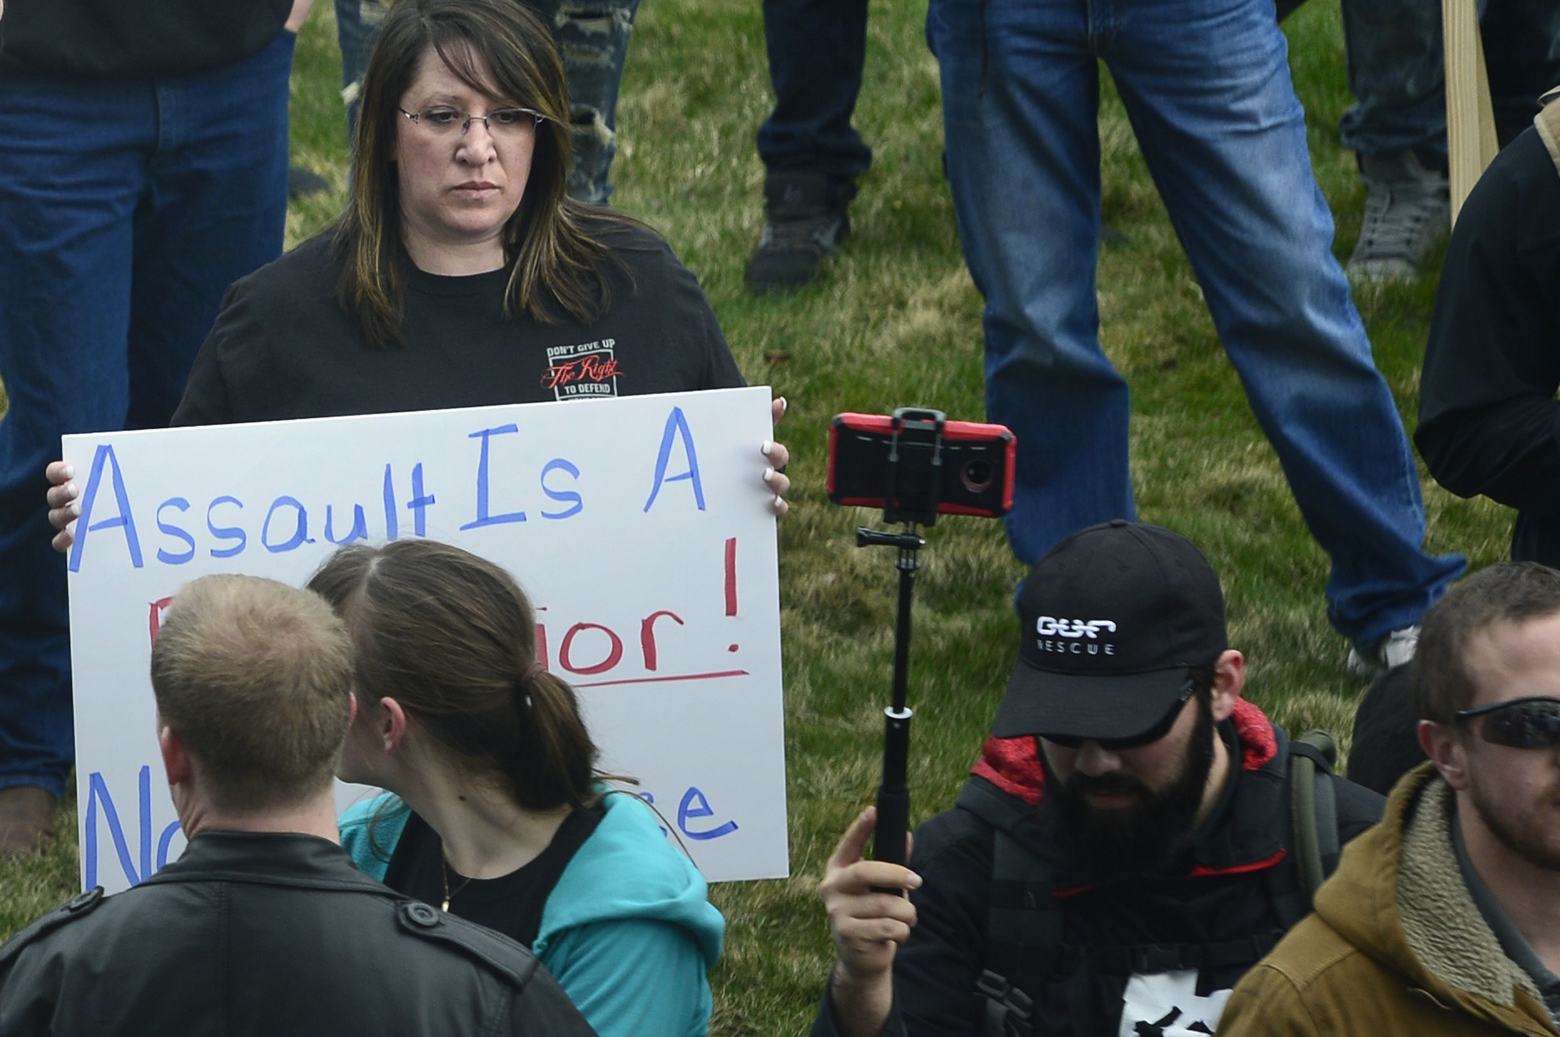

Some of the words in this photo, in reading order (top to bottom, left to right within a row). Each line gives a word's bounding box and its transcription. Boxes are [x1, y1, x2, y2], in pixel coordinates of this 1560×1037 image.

[546, 345, 575, 357] DON'T
[577, 341, 600, 352] GIVE
[602, 338, 615, 349] UP
[542, 363, 576, 389] The
[577, 354, 625, 382] Right
[564, 385, 576, 395] TO
[578, 383, 611, 394] DEFEND
[69, 444, 436, 572] Assault
[460, 423, 582, 531] Is
[644, 406, 707, 514] A
[1037, 639, 1115, 655] RESCUE
